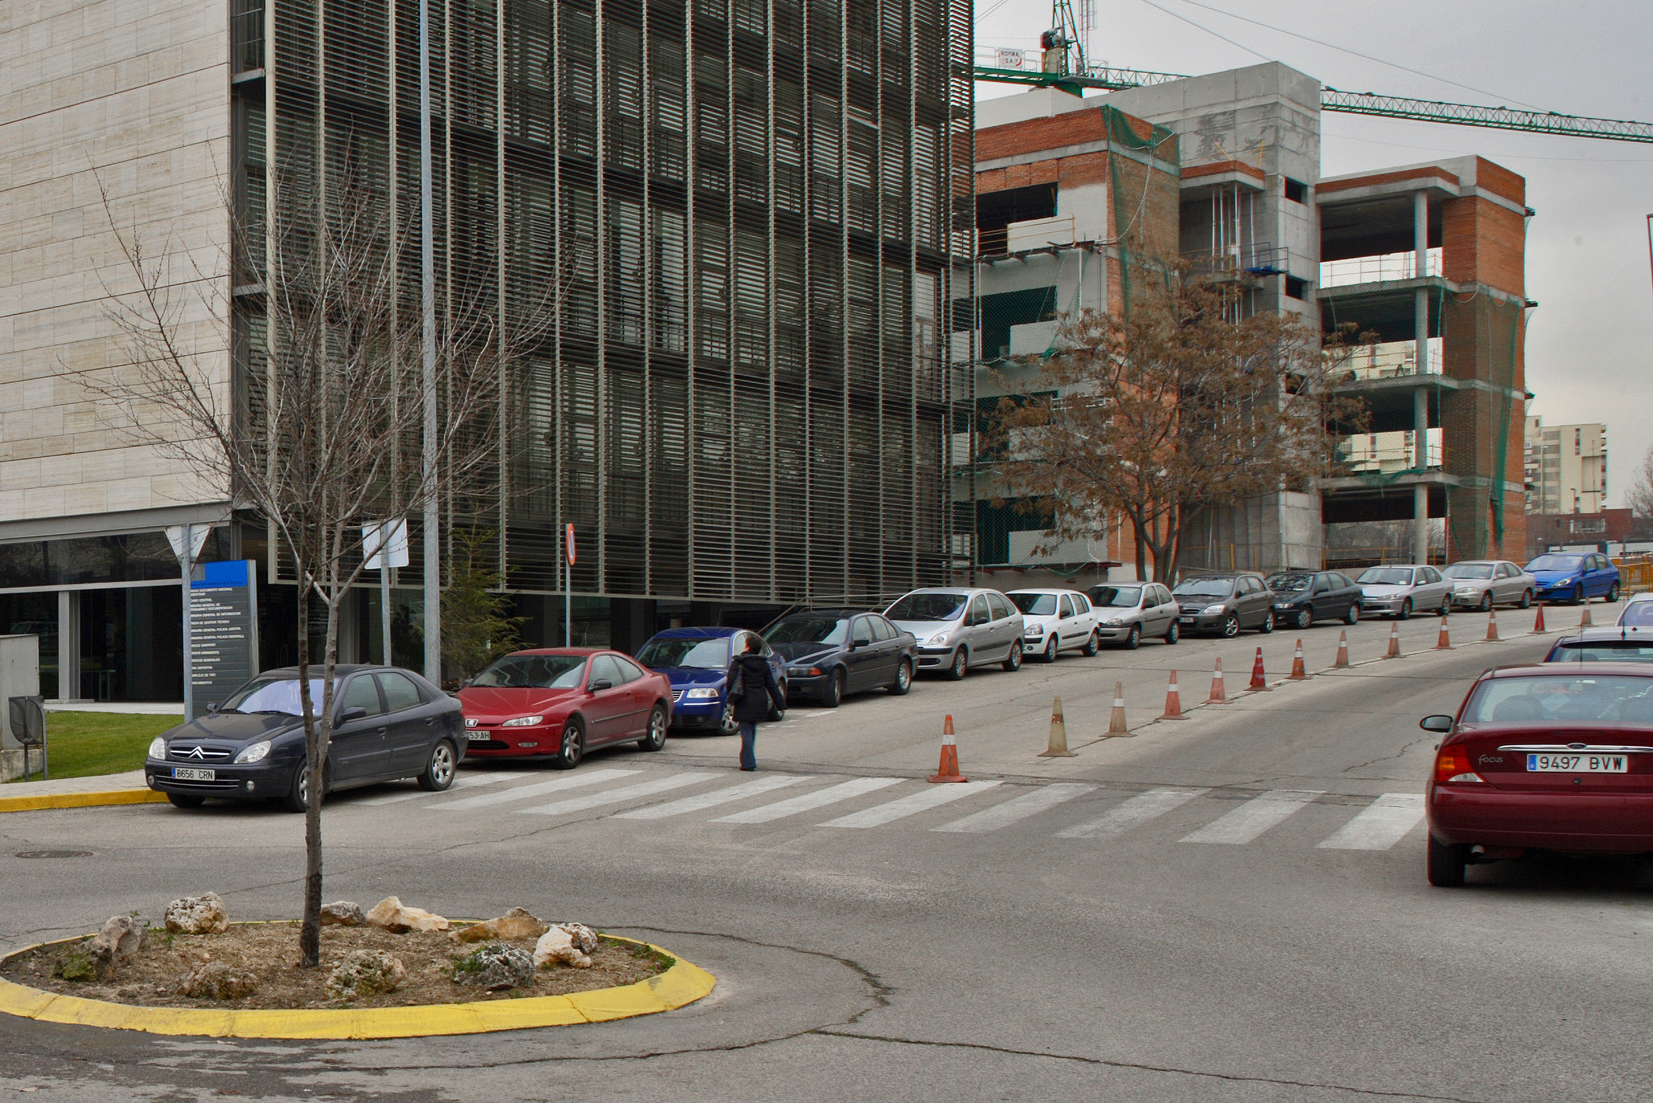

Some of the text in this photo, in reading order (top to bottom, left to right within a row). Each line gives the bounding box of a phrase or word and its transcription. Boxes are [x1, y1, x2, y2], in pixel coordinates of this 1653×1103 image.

[1539, 756, 1623, 771] 9497 BVW
[198, 770, 213, 779] CRN
